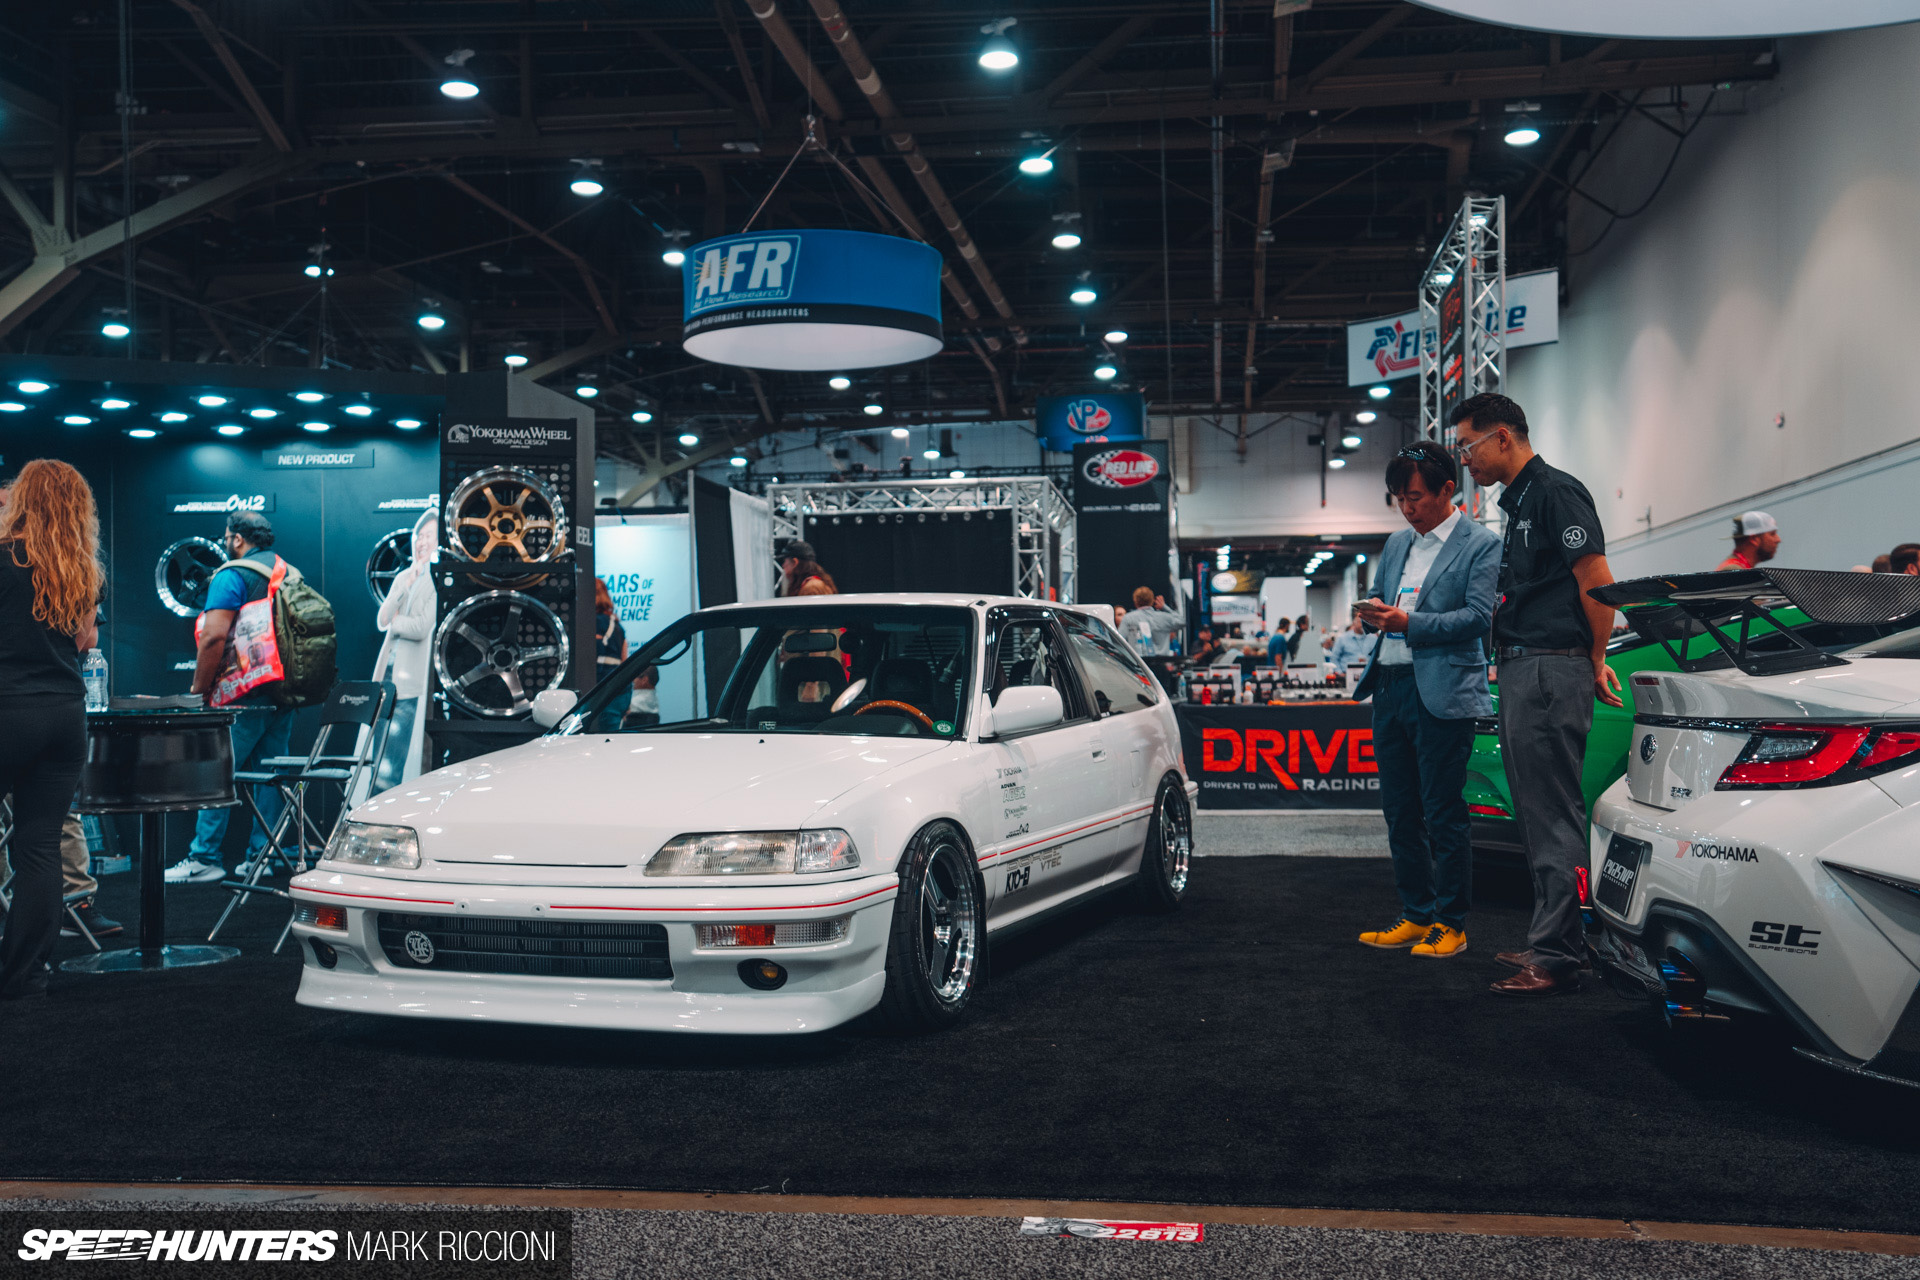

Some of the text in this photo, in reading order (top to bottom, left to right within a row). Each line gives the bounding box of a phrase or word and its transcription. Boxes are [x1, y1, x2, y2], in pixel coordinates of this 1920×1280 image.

[695, 241, 792, 300] AFR
[727, 288, 784, 301] Research
[746, 308, 810, 318] HEADQUARTERS
[1067, 399, 1099, 432] VP
[469, 425, 571, 440] YOKOHAMA WHEEL
[278, 453, 356, 465] NEW PRODUCT
[1105, 460, 1154, 474] RED LINE
[597, 573, 655, 593] ARS OF
[613, 594, 655, 608] MOTIVE
[222, 664, 273, 695] SPYDER
[1202, 728, 1379, 791] DRIVE
[1203, 781, 1240, 790] DRIVEN
[1243, 782, 1256, 790] TO
[1302, 778, 1380, 791] RACING
[1691, 843, 1759, 863] YOKOHAMA
[1040, 856, 1062, 872] VTEC
[1094, 1227, 1199, 1242] 22813
